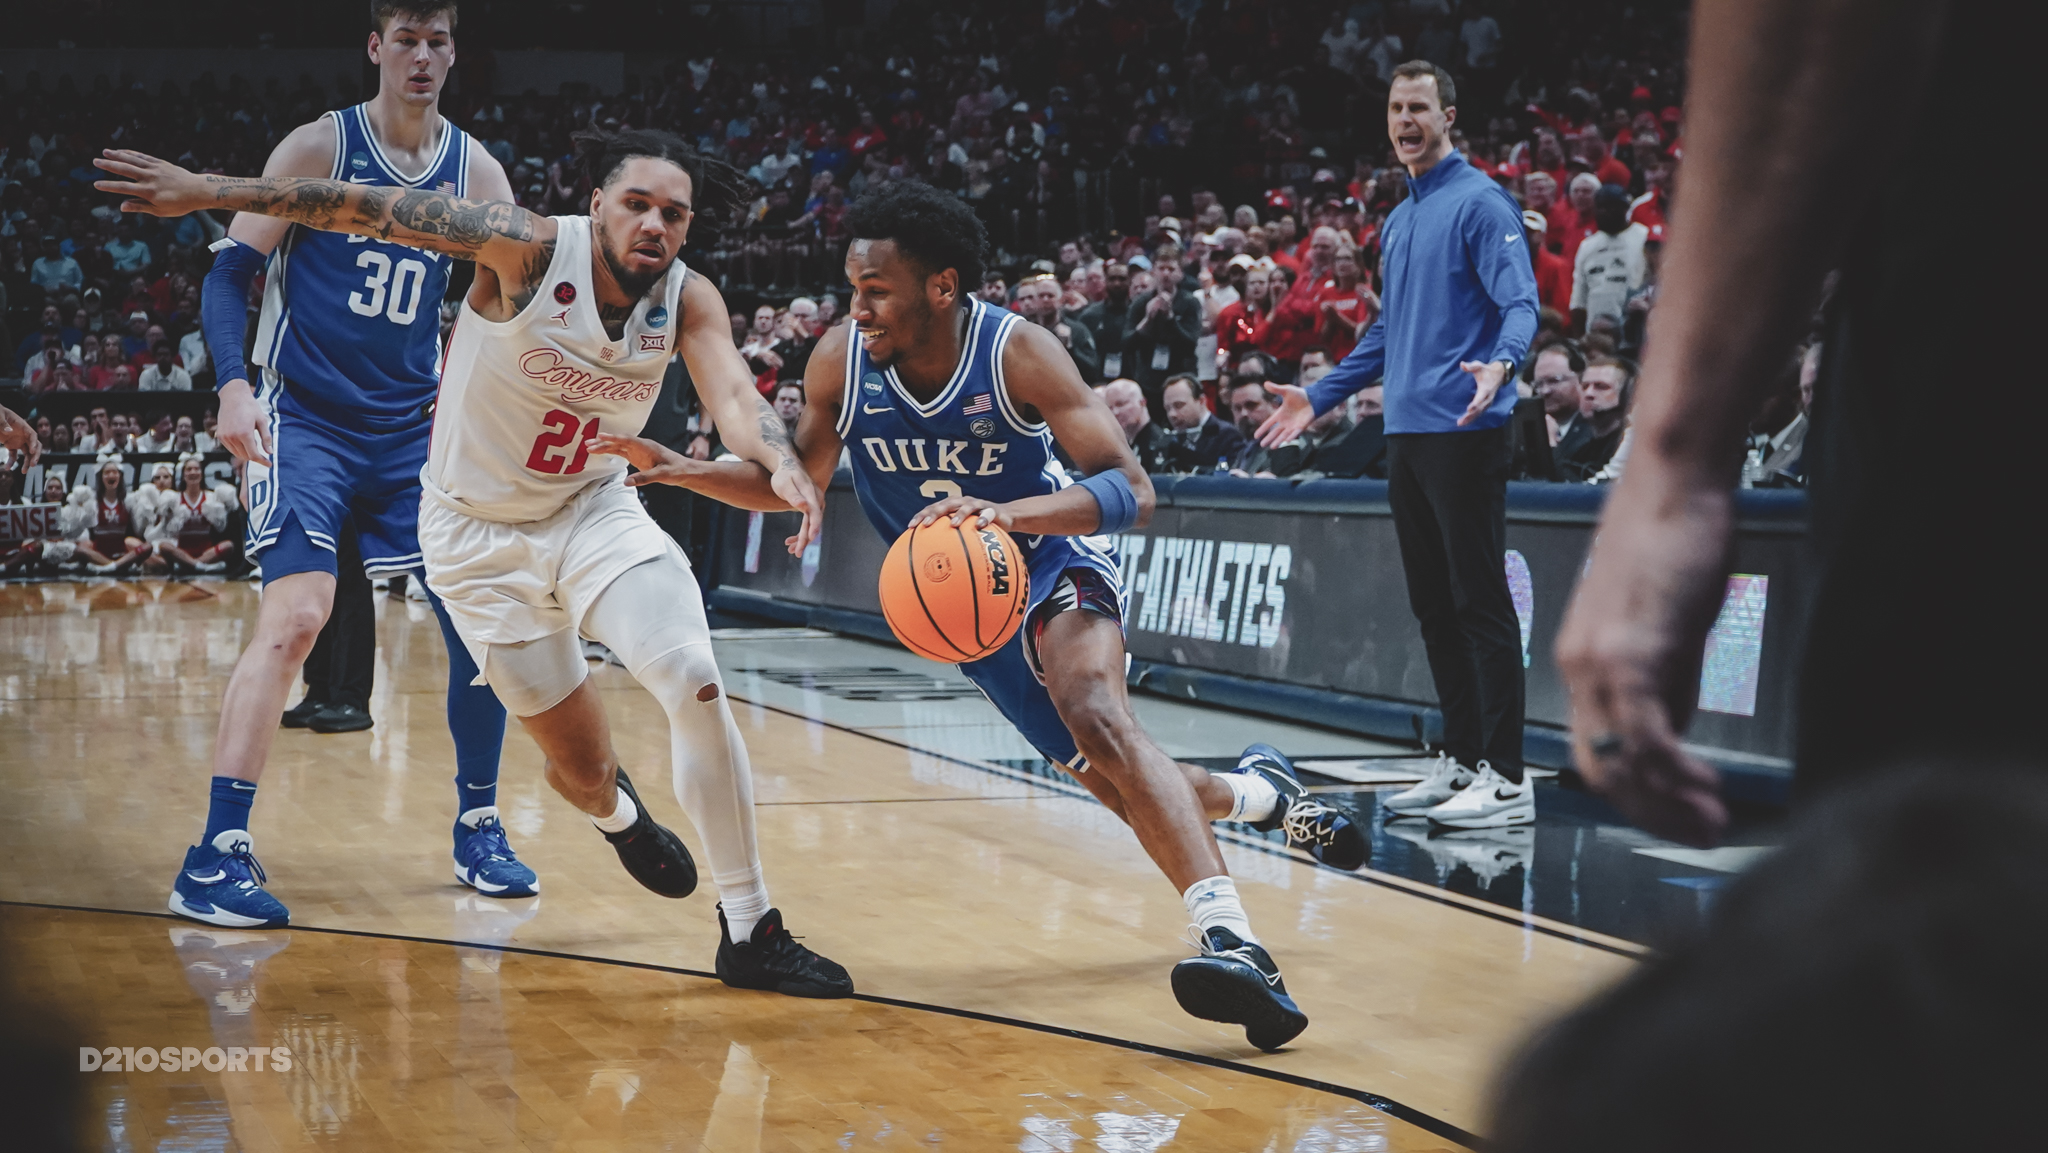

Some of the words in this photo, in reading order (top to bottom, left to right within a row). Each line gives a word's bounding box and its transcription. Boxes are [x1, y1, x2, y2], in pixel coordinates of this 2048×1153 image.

[348, 250, 426, 325] 30
[557, 285, 572, 298] 32
[519, 347, 660, 403] Cougars
[525, 408, 600, 474] 21
[862, 437, 1008, 476] DUKE
[977, 529, 1009, 596] NCAA
